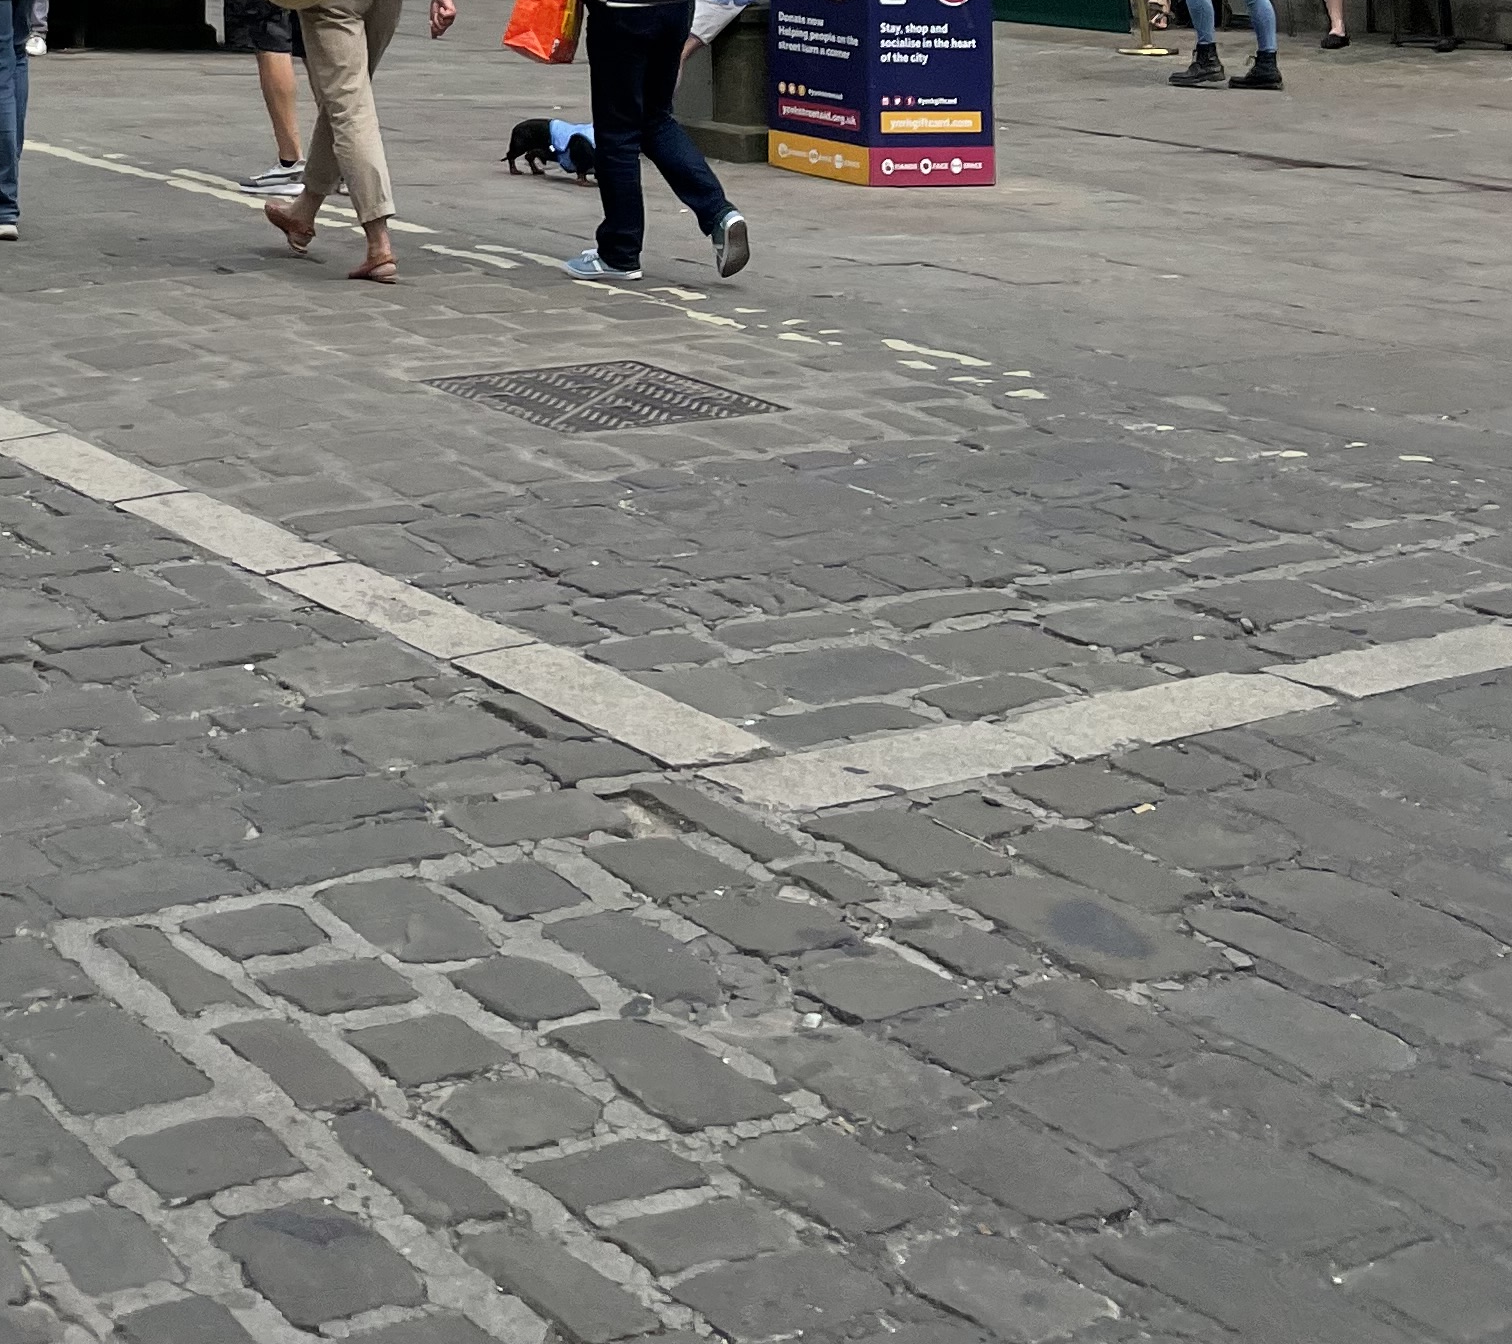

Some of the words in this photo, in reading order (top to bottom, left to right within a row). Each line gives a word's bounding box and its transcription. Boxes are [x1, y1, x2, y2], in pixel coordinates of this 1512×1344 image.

[880, 22, 903, 36] Stay,
[905, 23, 928, 36] shop
[930, 23, 948, 33] and
[809, 31, 836, 43] people
[880, 37, 921, 48] socialise
[922, 37, 932, 48] in
[933, 38, 949, 48] the
[950, 37, 977, 48] heart
[880, 52, 891, 63] of
[892, 52, 908, 63] the
[910, 52, 928, 66] city
